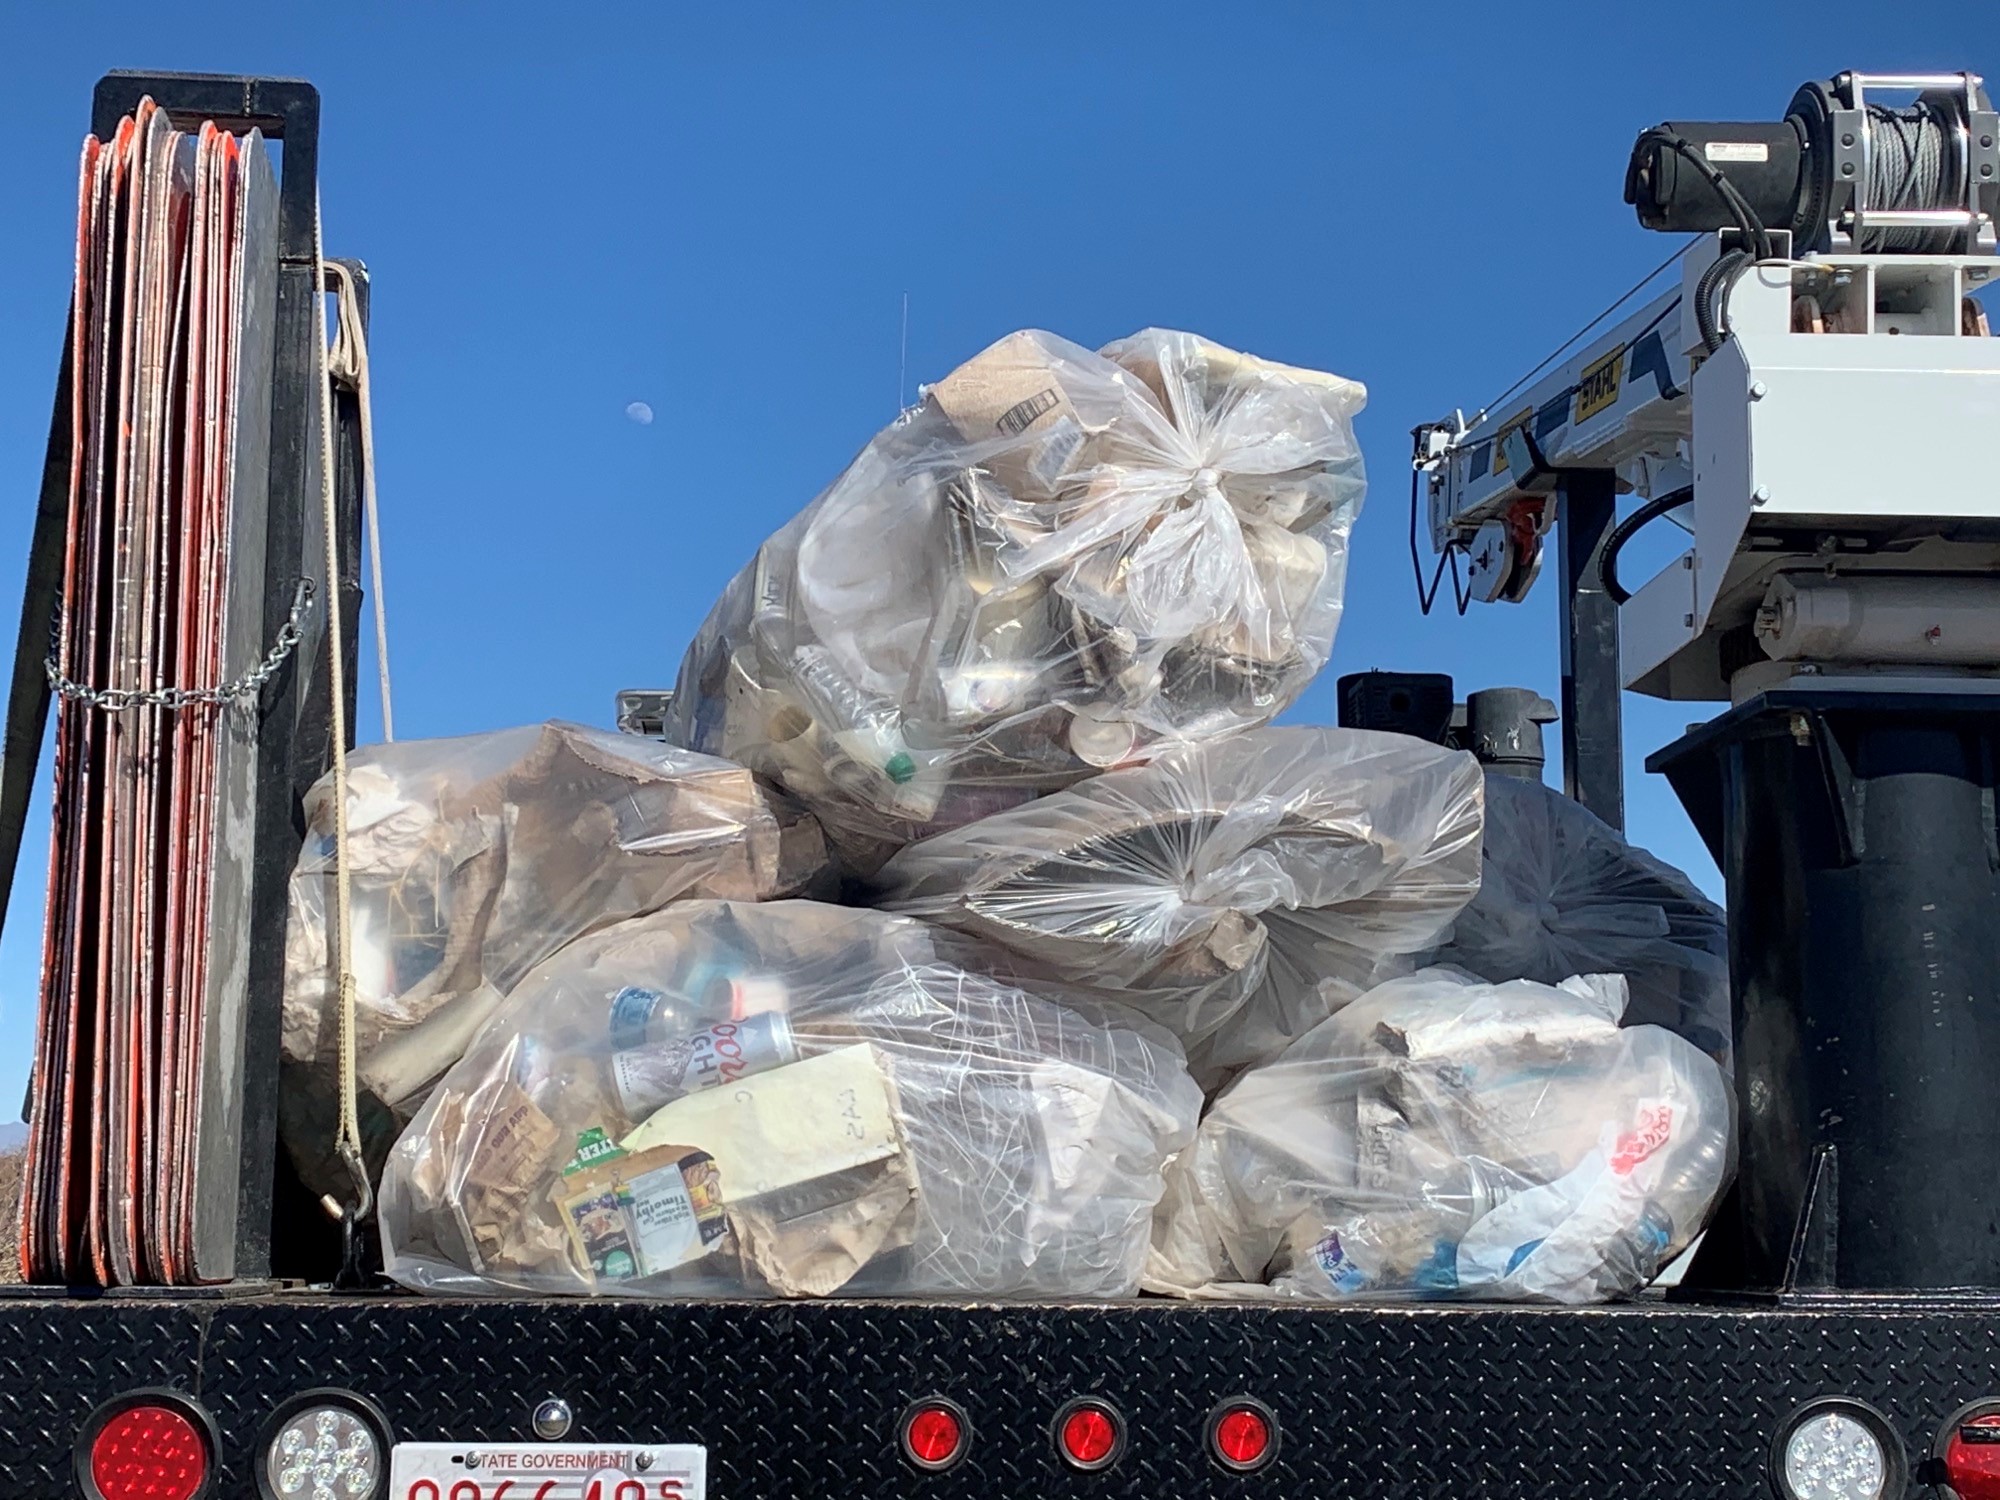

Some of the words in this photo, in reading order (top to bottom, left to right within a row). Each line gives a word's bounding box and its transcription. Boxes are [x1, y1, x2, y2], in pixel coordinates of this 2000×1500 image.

[711, 1016, 749, 1084] oor
[635, 1194, 687, 1220] Timothy
[479, 1454, 517, 1468] TATE
[521, 1454, 628, 1468] GOVERNMENT
